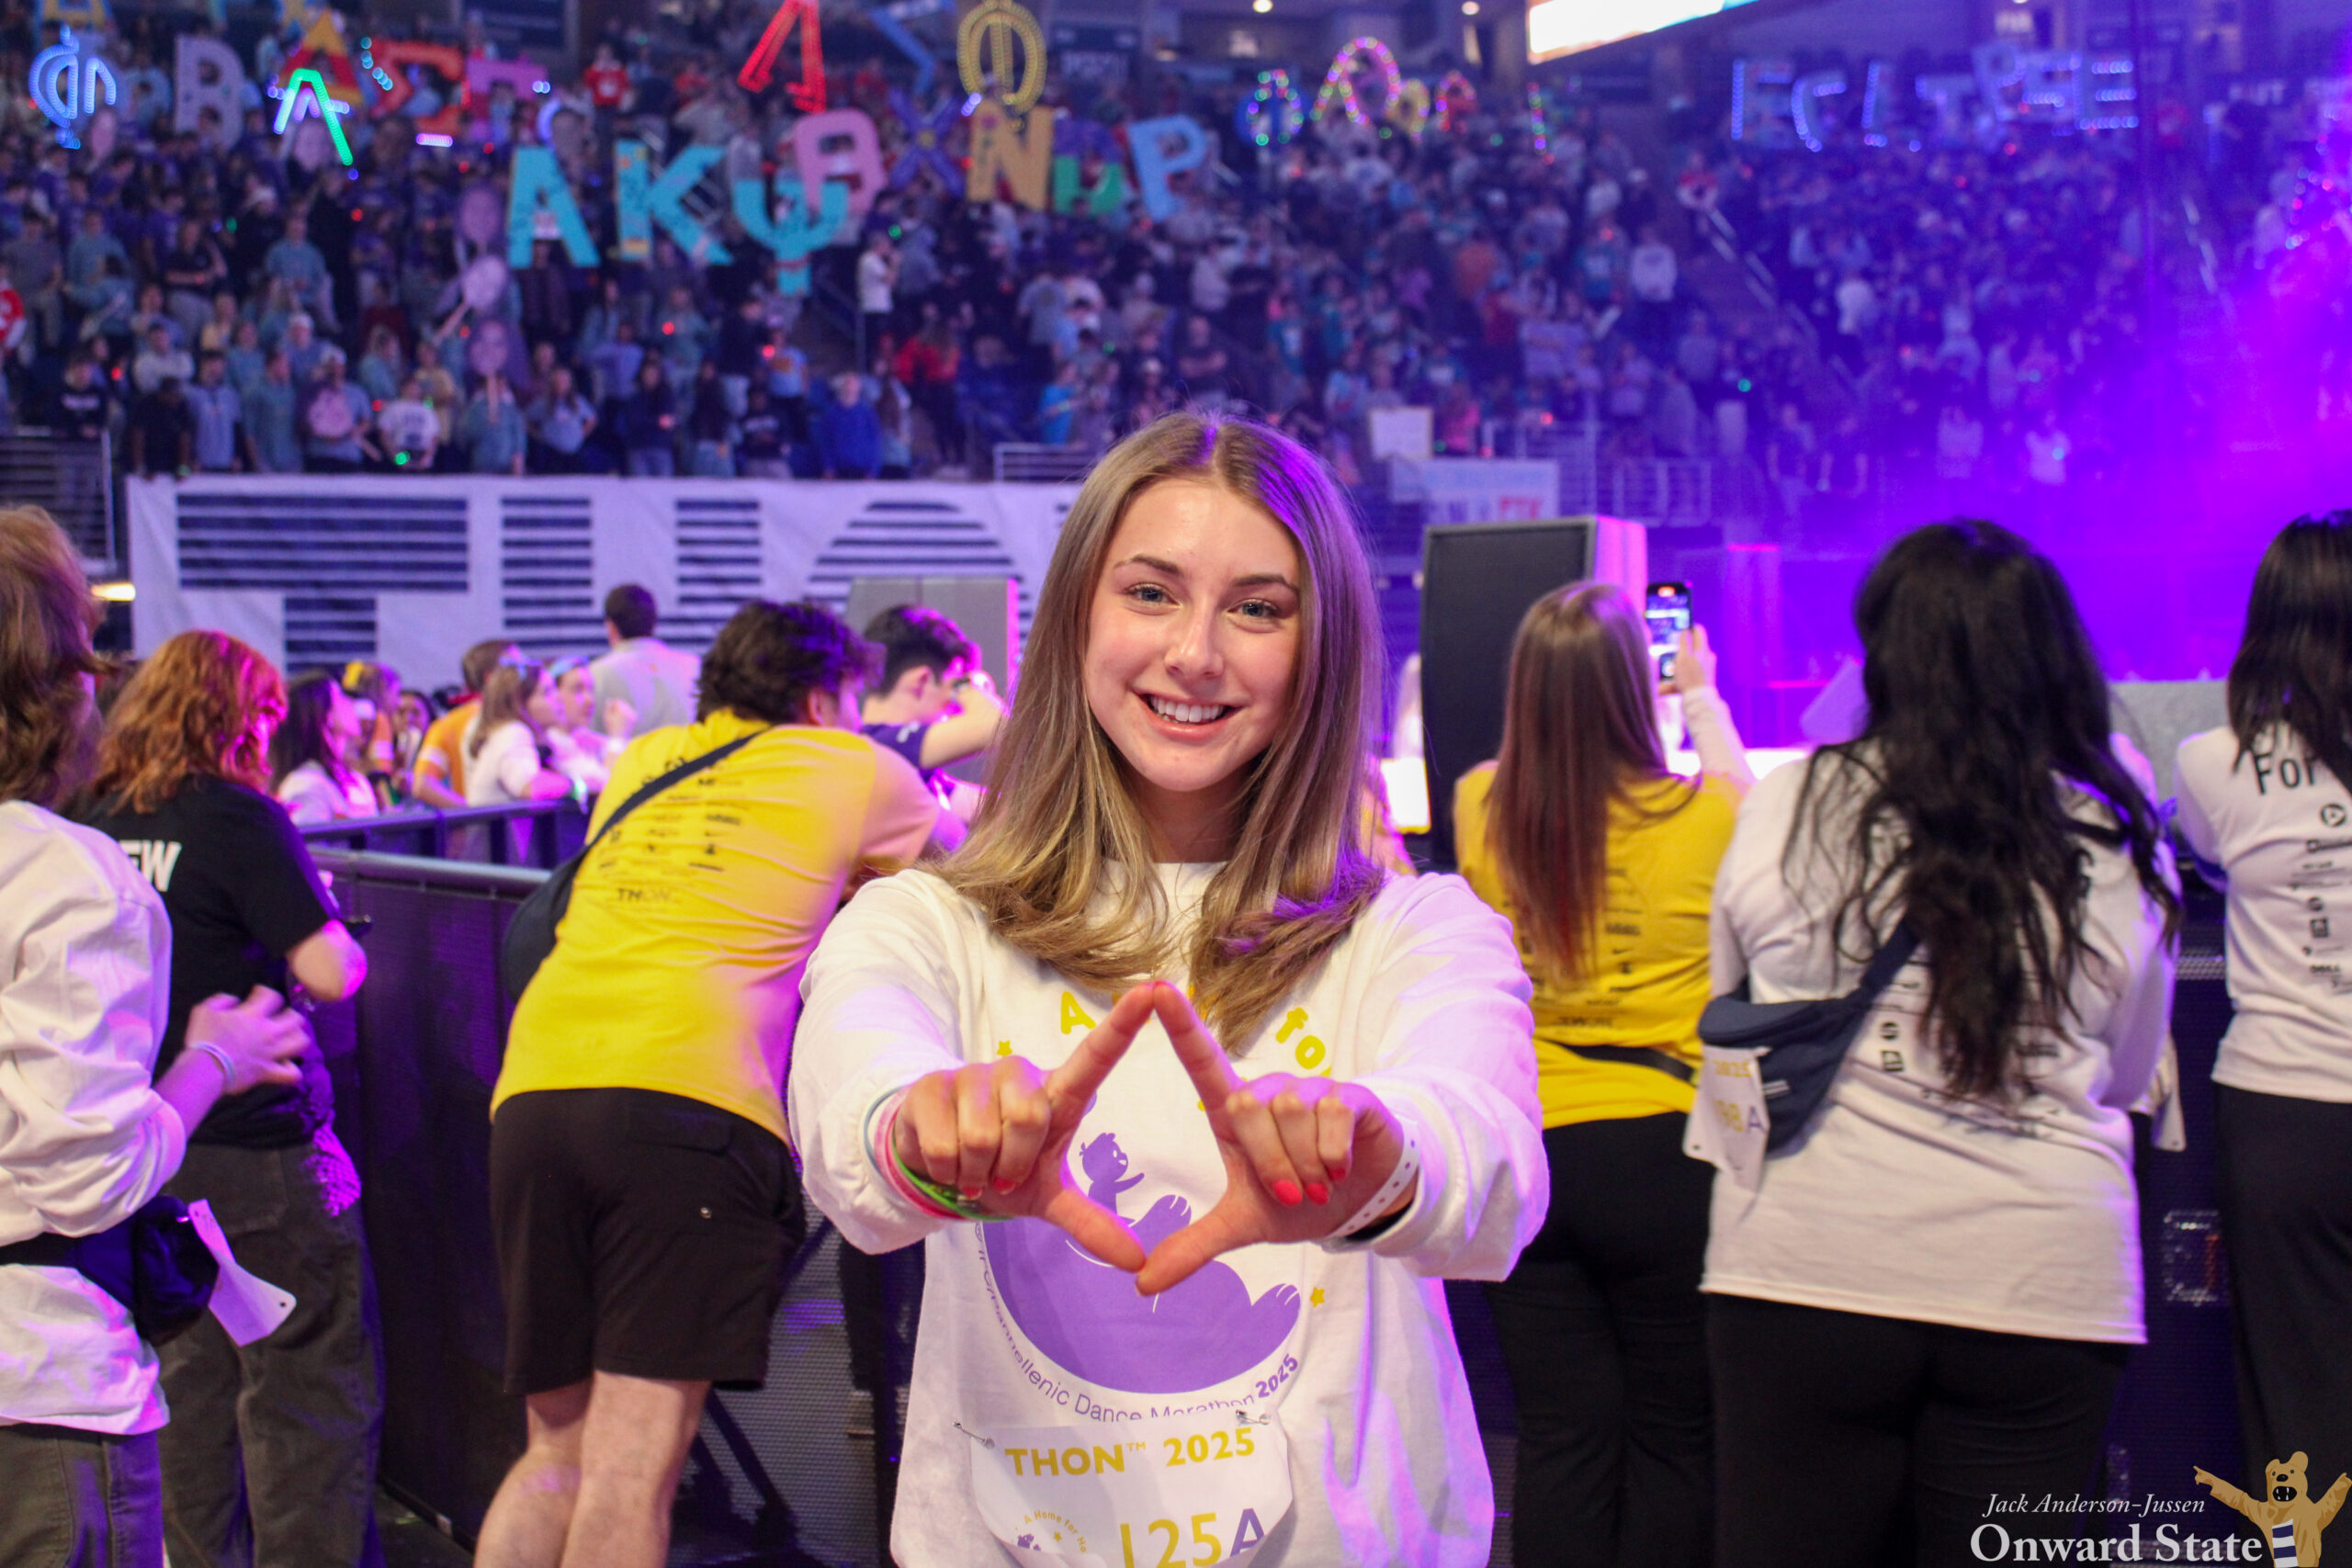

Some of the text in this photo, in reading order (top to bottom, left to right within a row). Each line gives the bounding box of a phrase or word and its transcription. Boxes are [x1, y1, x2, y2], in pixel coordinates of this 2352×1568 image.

[1060, 991, 1096, 1035] A
[1275, 1007, 1331, 1077] fo
[1075, 1393, 1142, 1423] Dance
[1255, 1353, 1298, 1398] 2025
[1163, 1427, 1255, 1467] 2025
[1034, 1510, 1062, 1522] Home
[1064, 1518, 1079, 1535] for
